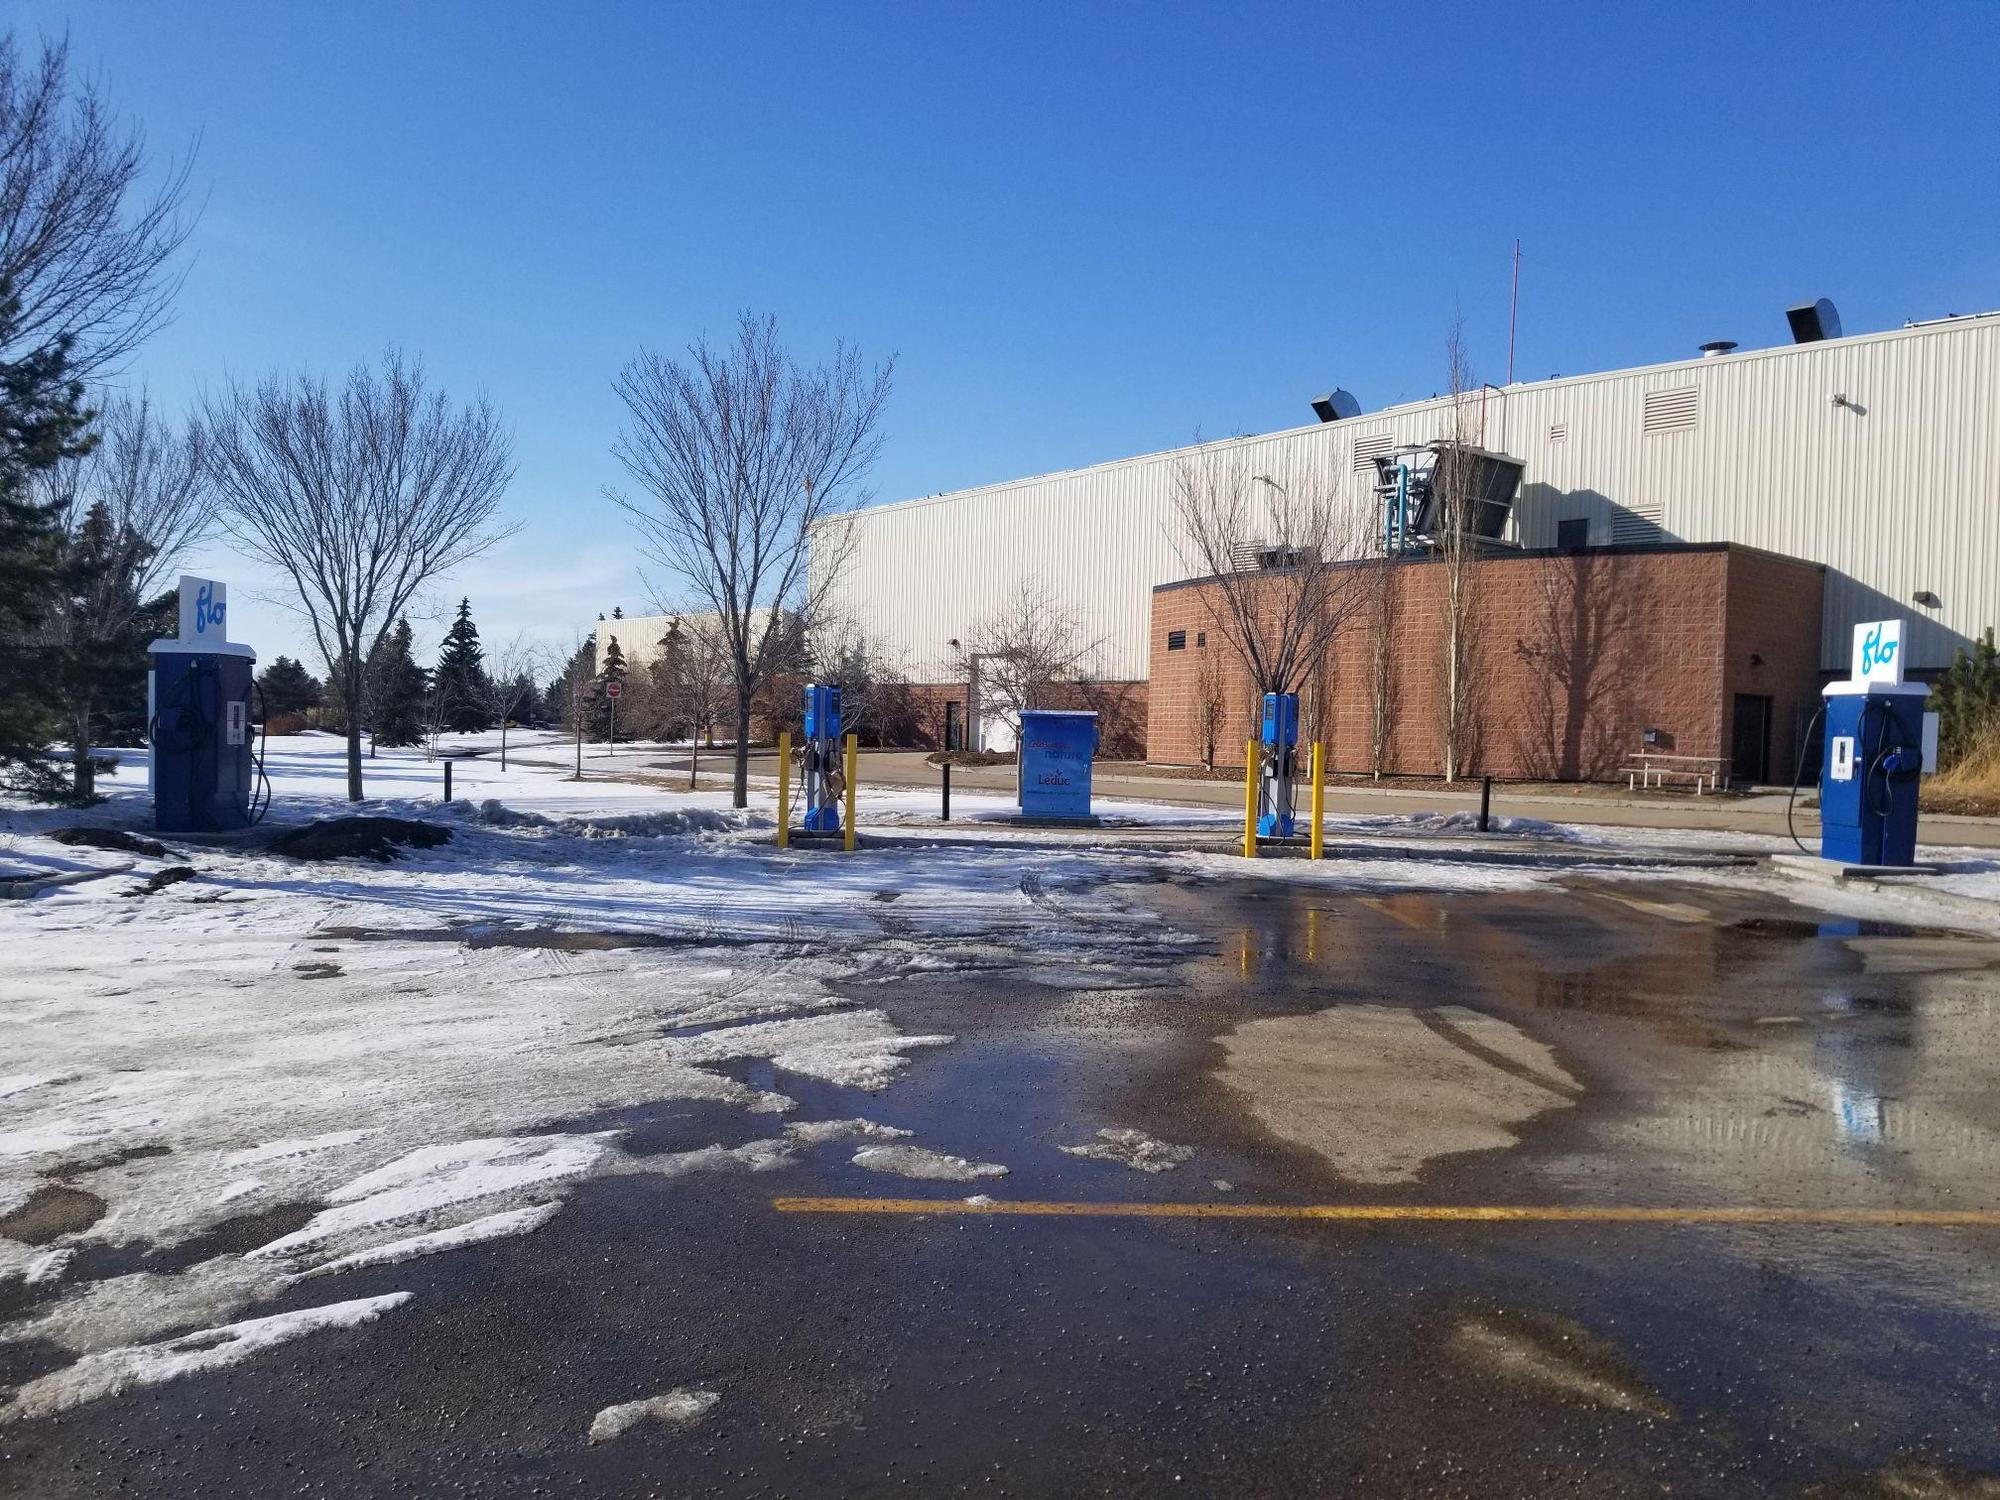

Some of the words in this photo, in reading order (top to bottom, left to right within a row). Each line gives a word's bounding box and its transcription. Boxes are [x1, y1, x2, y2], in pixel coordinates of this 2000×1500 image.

[196, 581, 226, 634] flo
[1862, 622, 1898, 675] flo
[1044, 749, 1084, 760] nature
[1038, 773, 1071, 786] Leduc
